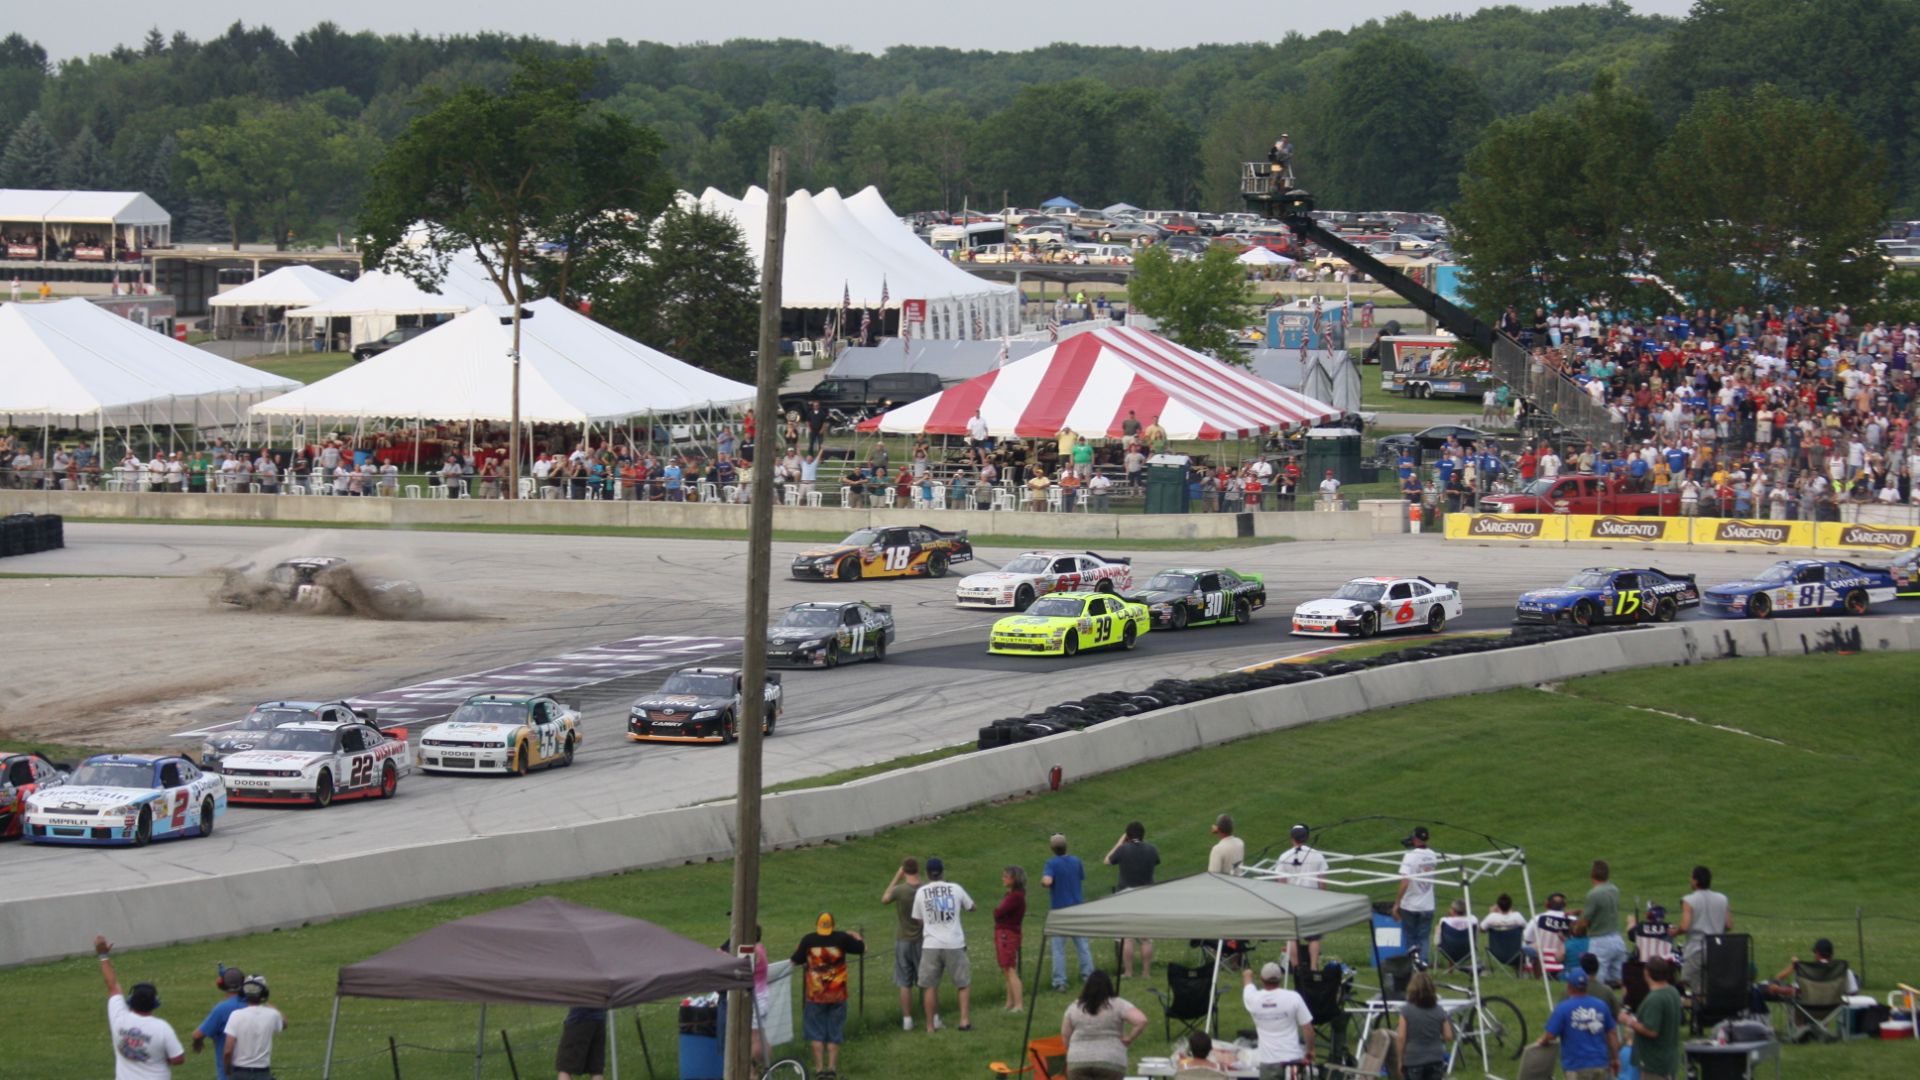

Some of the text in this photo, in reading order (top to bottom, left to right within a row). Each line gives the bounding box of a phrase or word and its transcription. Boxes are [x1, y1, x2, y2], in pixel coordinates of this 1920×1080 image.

[1474, 519, 1534, 533] SARGENTO
[1597, 521, 1657, 535] SARGENTO
[1721, 524, 1782, 540] SARGENTO
[1846, 529, 1907, 545] SARGENTO
[885, 546, 911, 571] 18
[1056, 574, 1081, 592] 67
[1204, 593, 1223, 617] 30
[1615, 590, 1641, 615] 15
[1799, 584, 1824, 607] 81
[1395, 600, 1414, 624] 6
[851, 626, 865, 654] 11
[1094, 616, 1112, 643] 39
[350, 755, 373, 786] 22
[171, 788, 189, 828] 2
[923, 886, 953, 899] THERE
